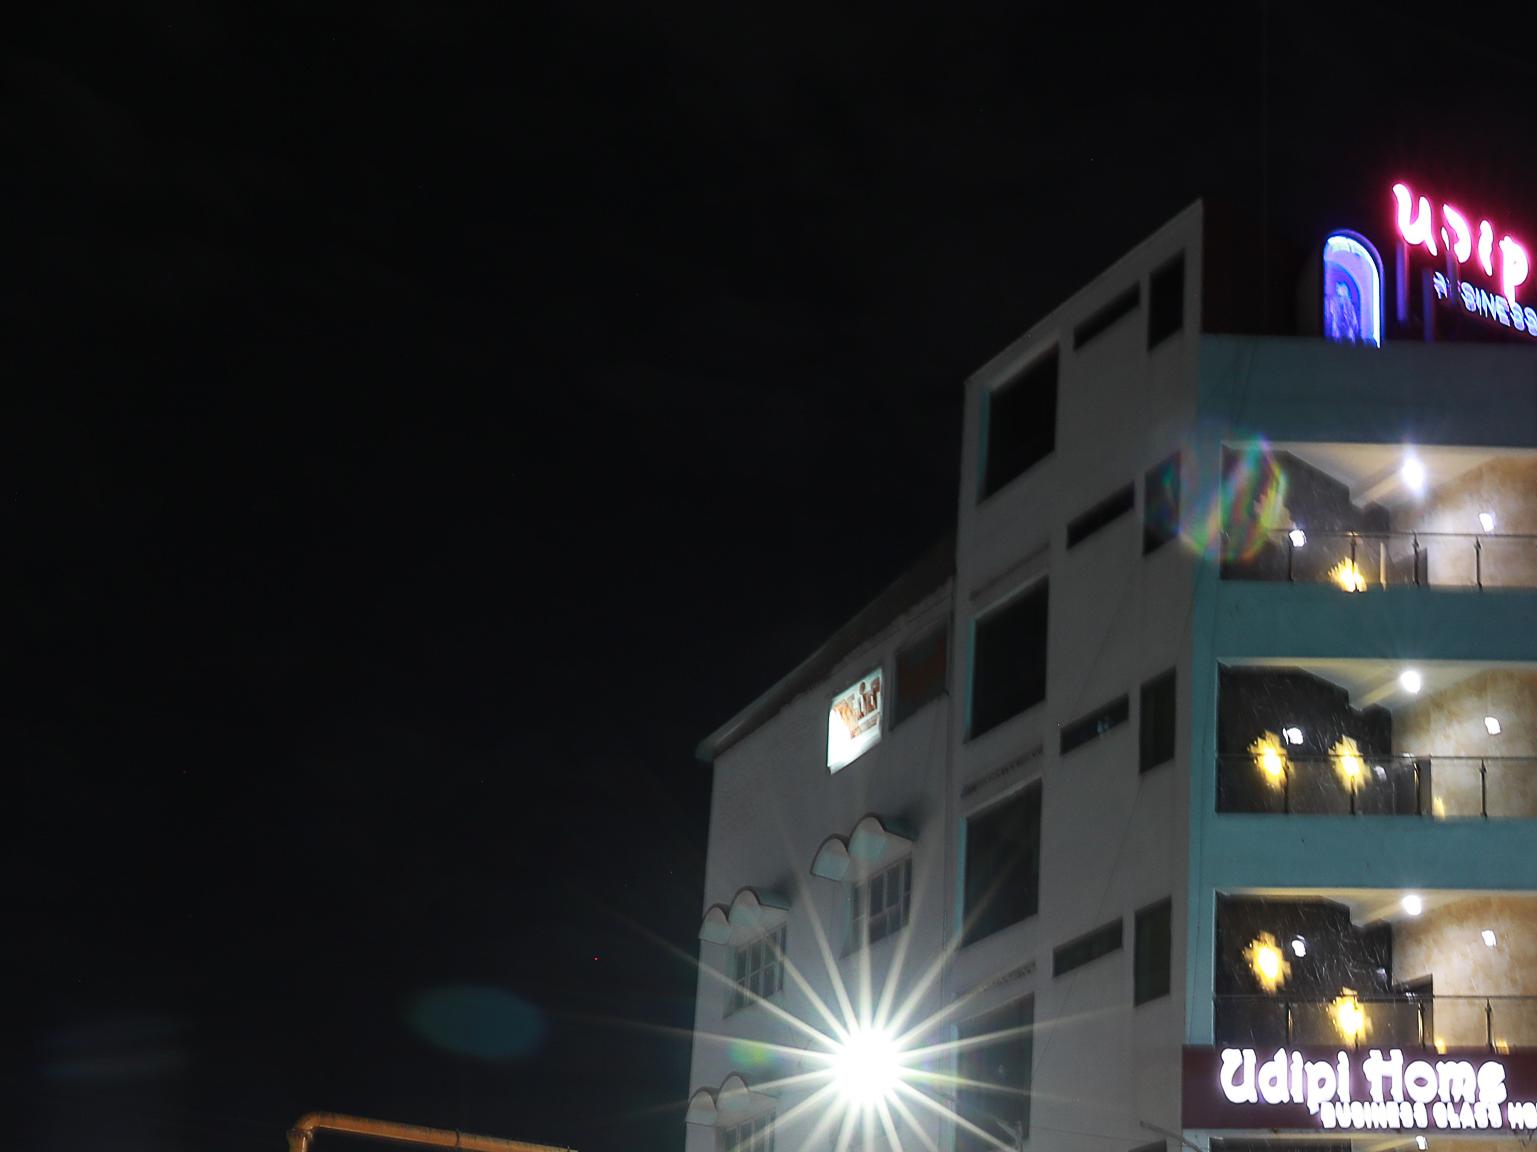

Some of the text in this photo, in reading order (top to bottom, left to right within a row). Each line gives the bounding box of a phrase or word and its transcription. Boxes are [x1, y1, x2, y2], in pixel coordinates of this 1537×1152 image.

[1219, 1048, 1351, 1115] Udipi
[1319, 1101, 1429, 1129] BUSINESS
[1431, 1102, 1503, 1130] CLASS
